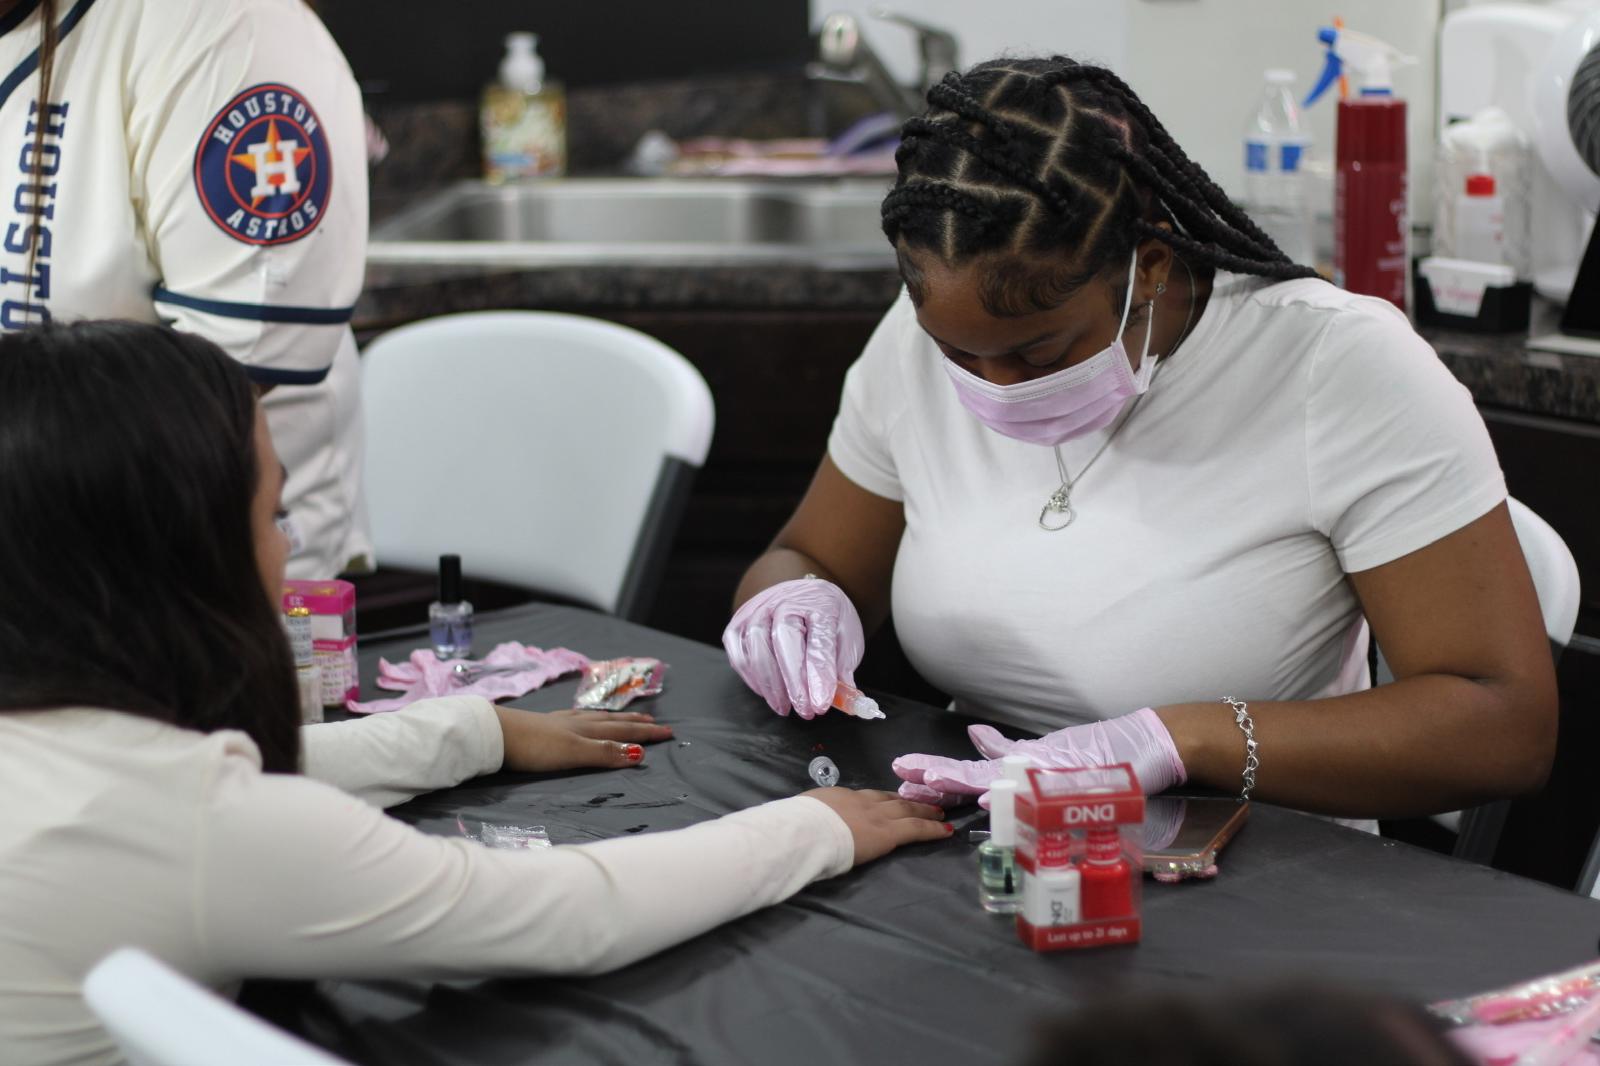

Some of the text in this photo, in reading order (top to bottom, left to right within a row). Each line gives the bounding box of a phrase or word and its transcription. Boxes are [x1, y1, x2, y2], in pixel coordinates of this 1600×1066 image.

[213, 93, 317, 145] HOUSTON
[247, 139, 301, 197] H
[0, 100, 69, 331] HOUSTO
[226, 200, 319, 239] ASTROS
[1046, 931, 1067, 943] Last
[1069, 931, 1081, 943] up
[1082, 930, 1094, 939] to
[1107, 926, 1128, 939] days
